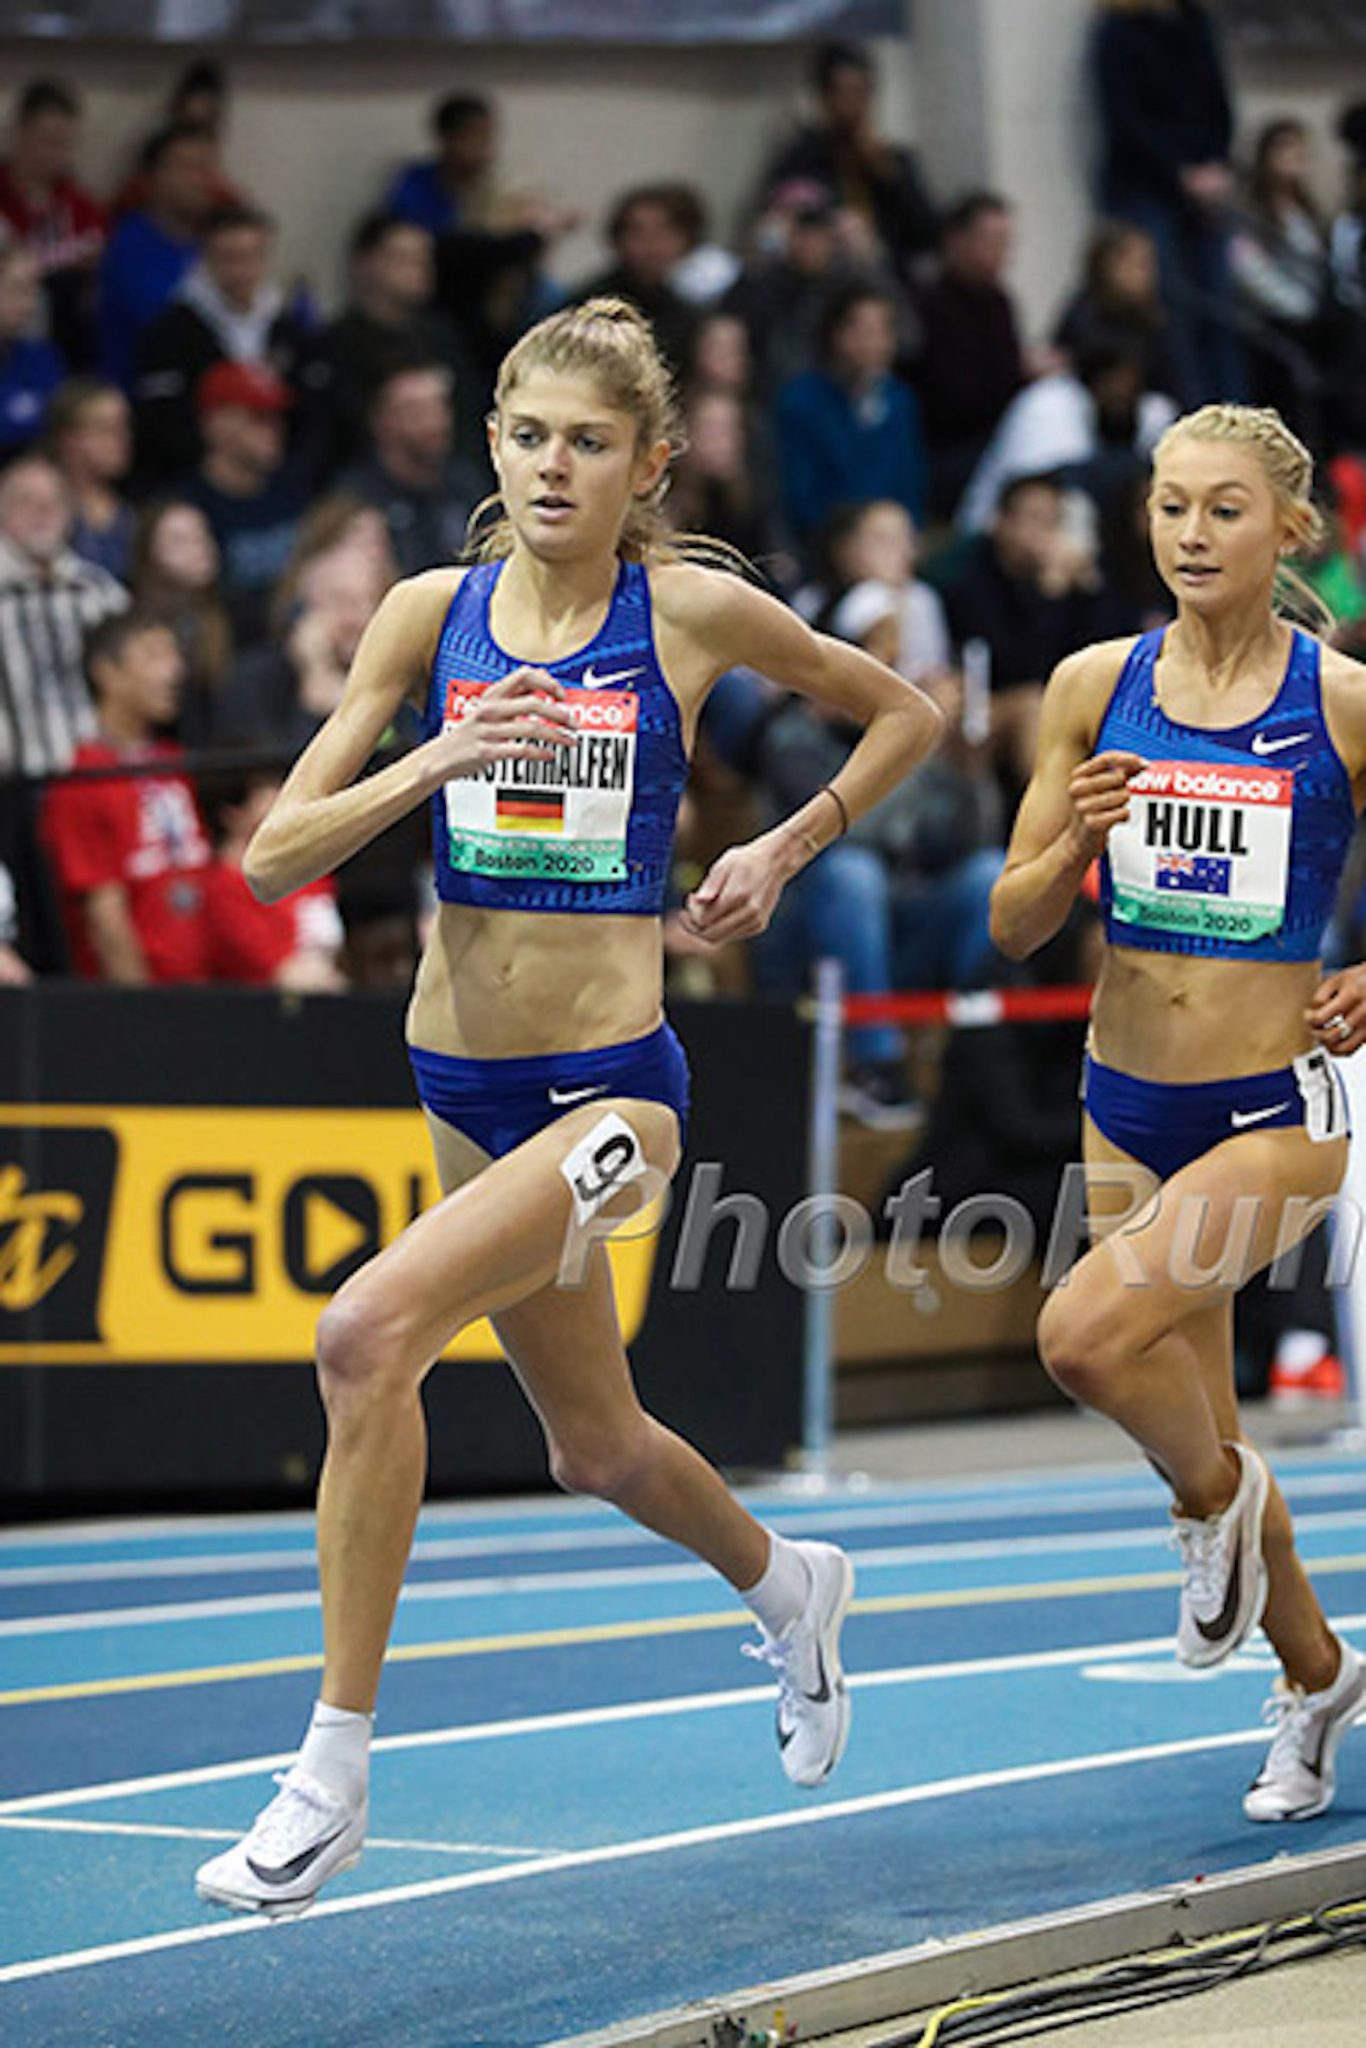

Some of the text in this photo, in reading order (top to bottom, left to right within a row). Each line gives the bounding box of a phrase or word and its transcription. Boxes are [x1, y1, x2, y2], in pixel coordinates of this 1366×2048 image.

[1174, 771, 1280, 800] balance
[1146, 802, 1249, 856] HULL
[474, 849, 595, 874] Boston 2020
[1203, 913, 1253, 933] 2020
